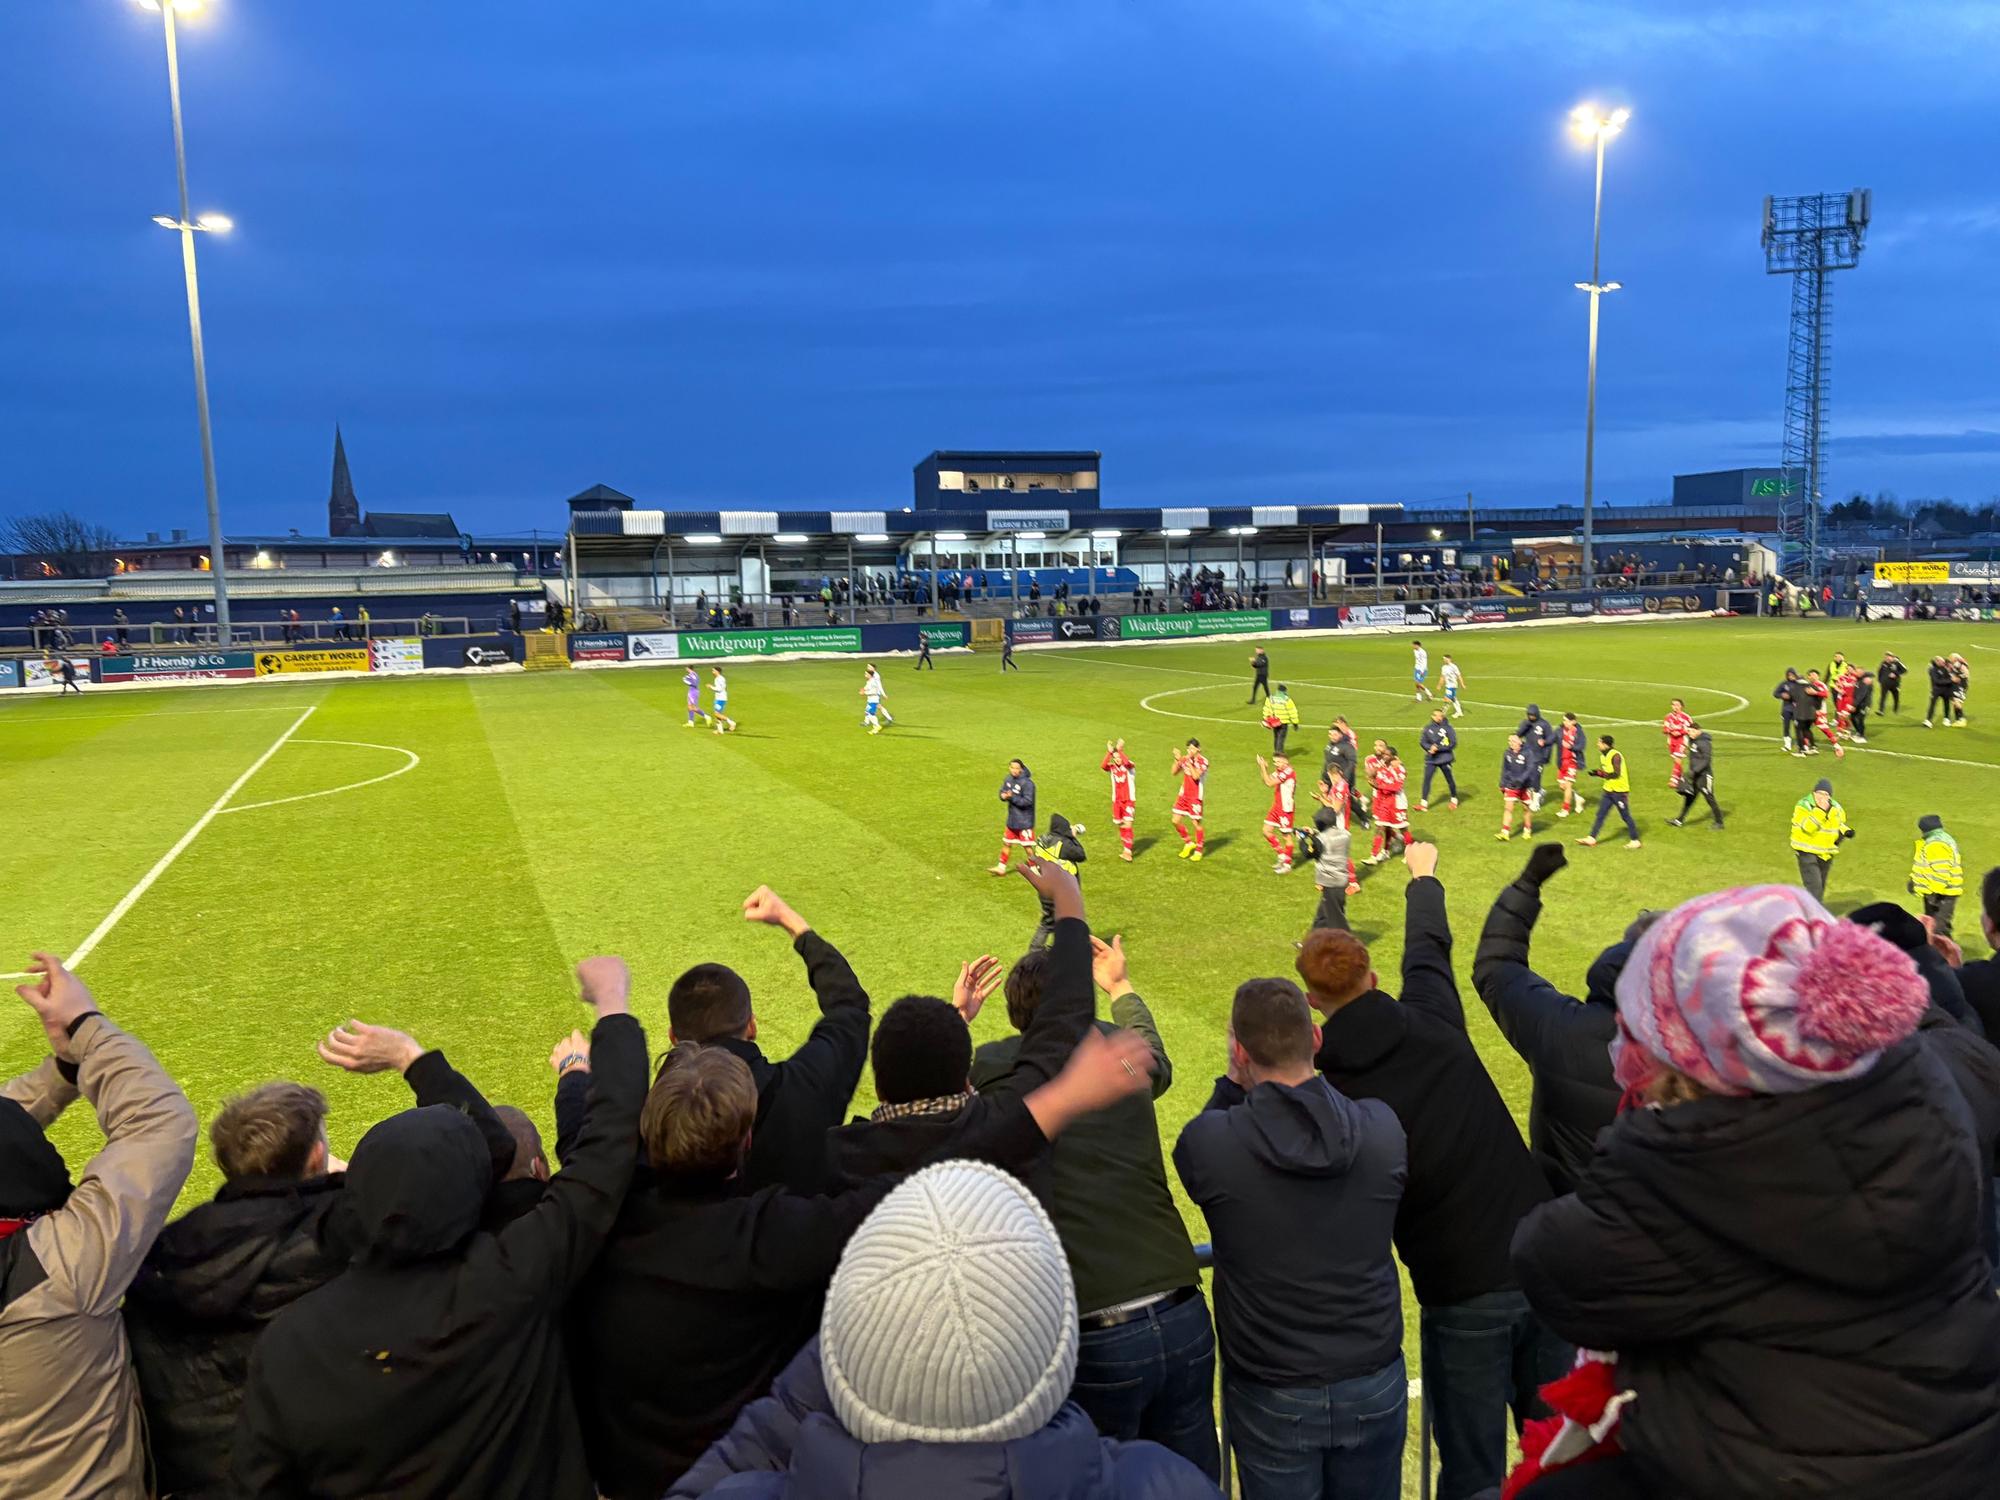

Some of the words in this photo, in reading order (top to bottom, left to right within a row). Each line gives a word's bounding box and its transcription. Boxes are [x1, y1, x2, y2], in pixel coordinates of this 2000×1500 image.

[1127, 618, 1194, 634] Wardgroup
[686, 636, 766, 653] Wardgroup
[133, 657, 140, 668] J
[142, 657, 150, 667] F
[151, 656, 196, 668] Hornby
[198, 656, 208, 666] &
[209, 655, 225, 665] Co
[284, 653, 326, 662] CARPET
[329, 651, 366, 661] WORLD
